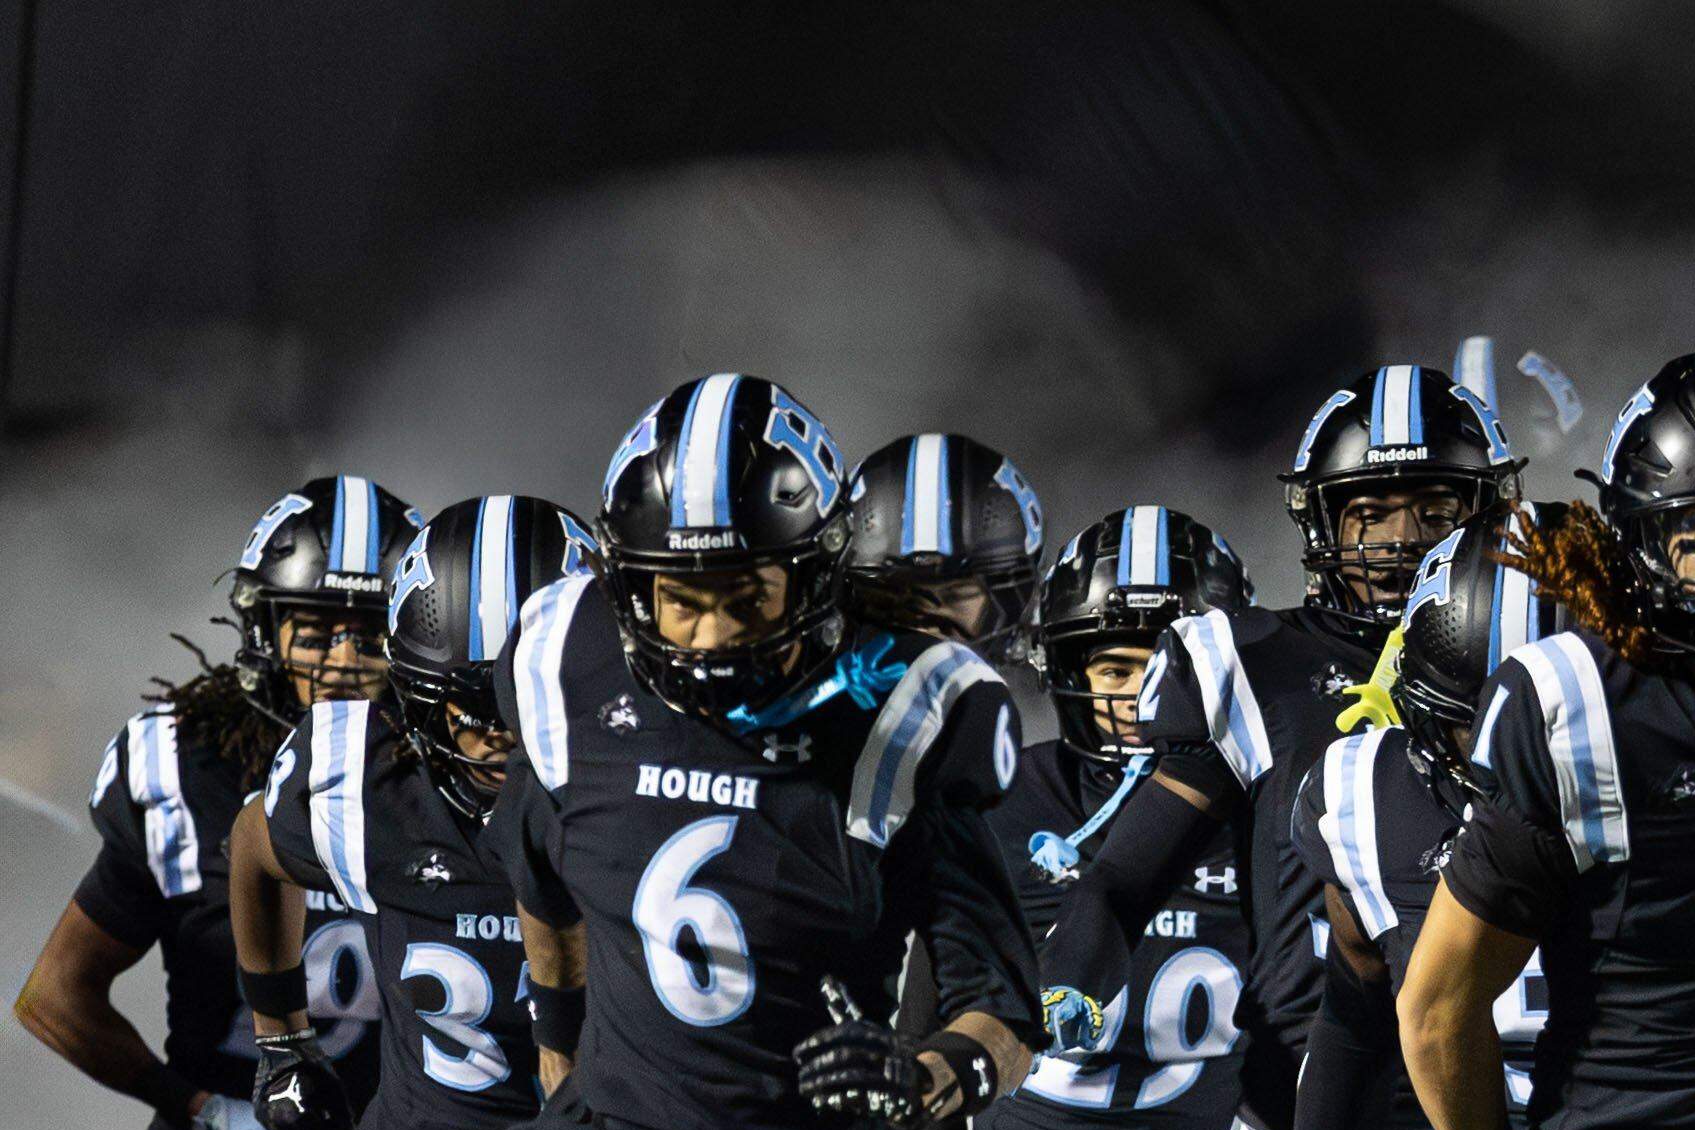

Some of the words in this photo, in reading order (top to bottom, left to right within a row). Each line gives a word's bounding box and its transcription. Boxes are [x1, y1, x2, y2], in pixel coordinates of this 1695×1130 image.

[1366, 446, 1428, 463] Riddell
[668, 531, 735, 550] Riddell
[324, 573, 383, 592] Riddell
[635, 764, 760, 810] HOUGH
[455, 912, 523, 942] HOU
[632, 814, 756, 1027] 6
[400, 941, 534, 1092] 3
